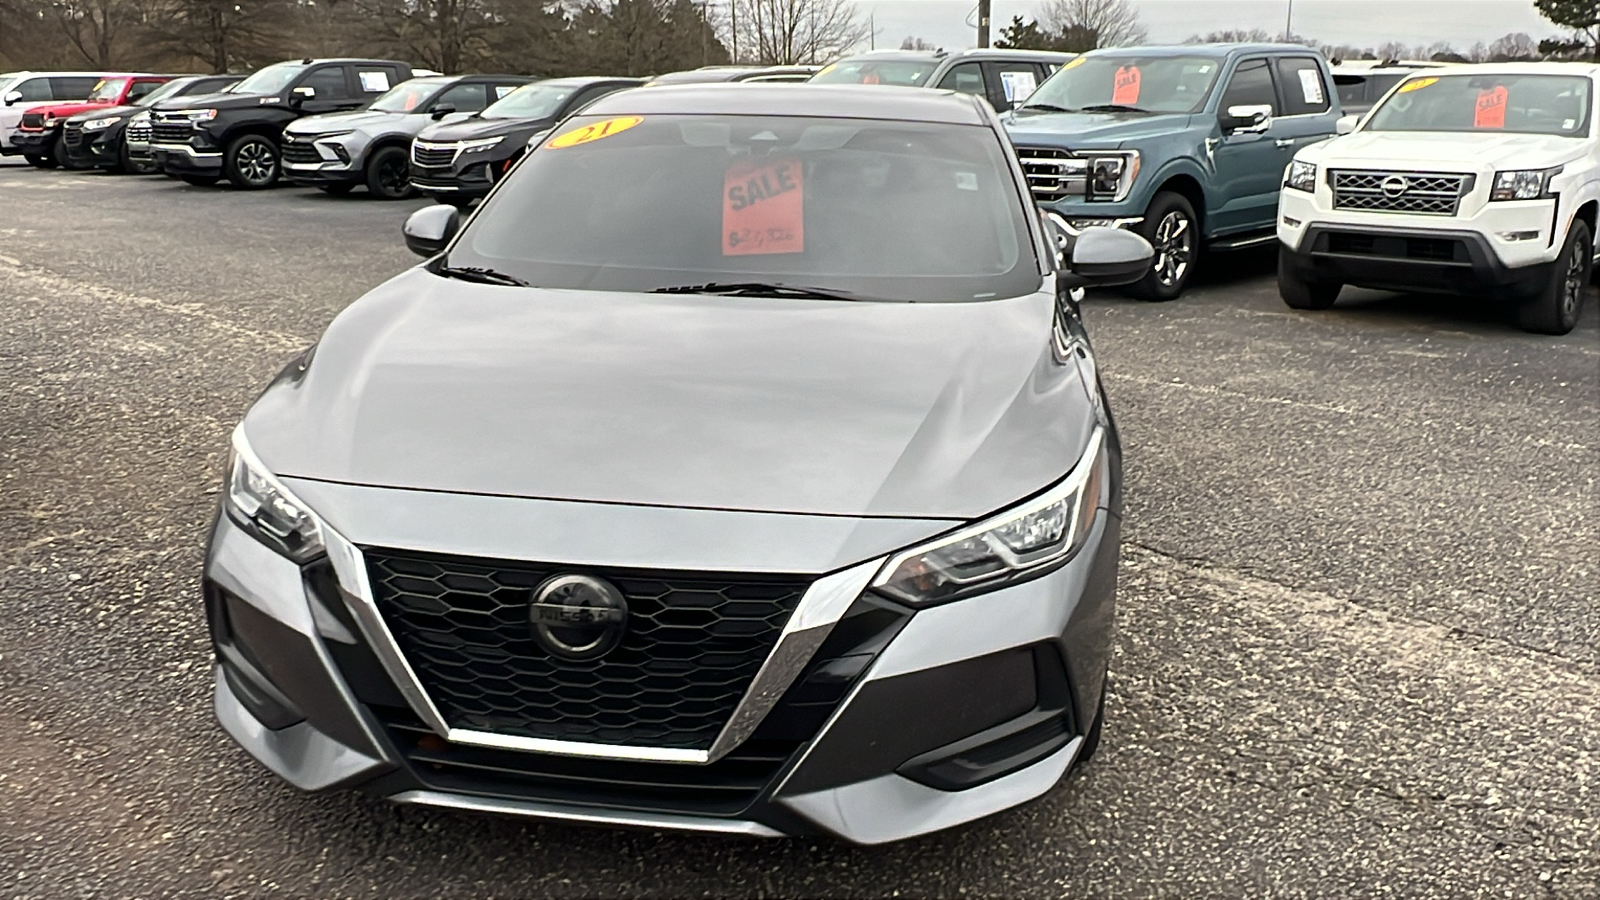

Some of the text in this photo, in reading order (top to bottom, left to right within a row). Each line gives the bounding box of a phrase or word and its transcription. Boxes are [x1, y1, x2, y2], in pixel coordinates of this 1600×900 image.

[1117, 73, 1137, 89] SALE
[1479, 94, 1503, 110] SALE
[576, 121, 613, 143] 21
[728, 164, 797, 211] SALE
